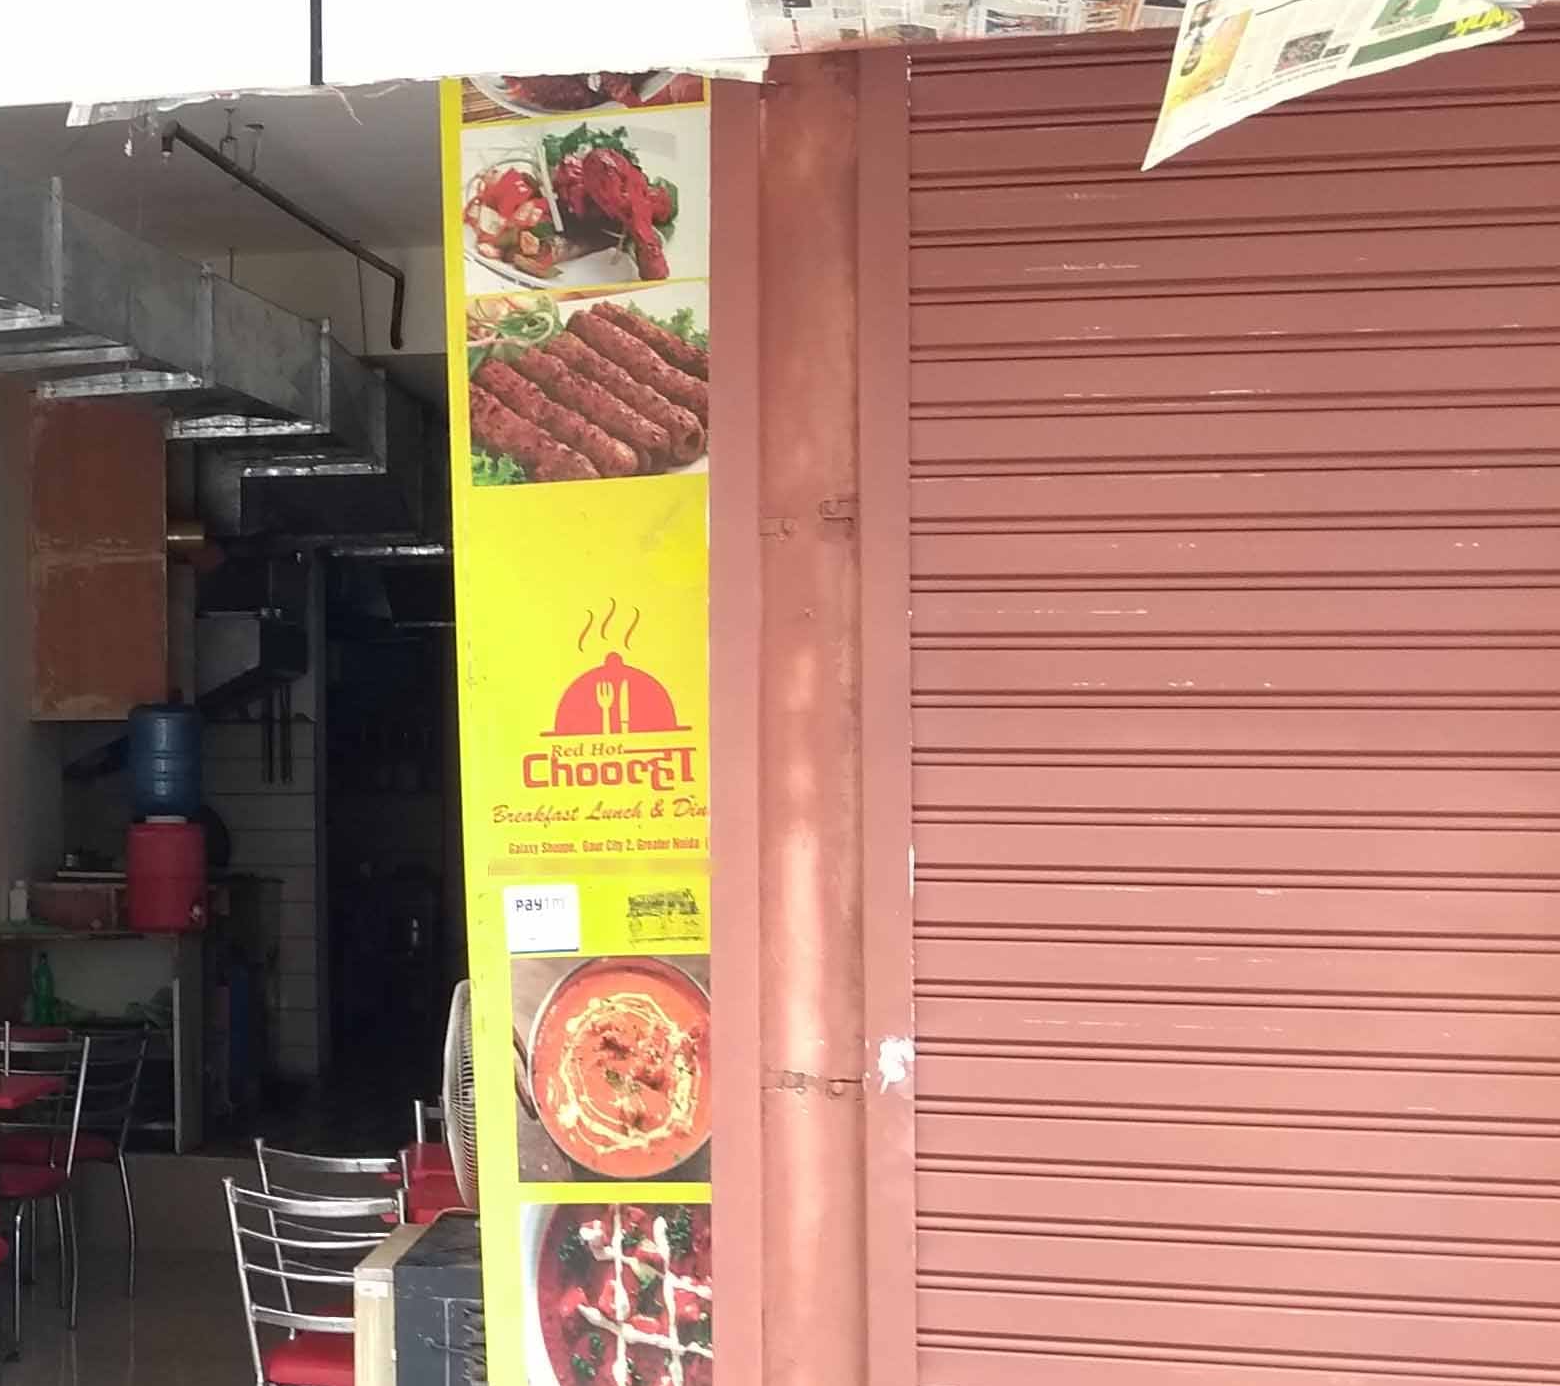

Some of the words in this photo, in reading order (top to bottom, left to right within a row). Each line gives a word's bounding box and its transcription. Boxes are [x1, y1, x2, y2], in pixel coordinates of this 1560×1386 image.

[551, 743, 584, 757] Red
[591, 743, 624, 757] Hot
[492, 804, 580, 829] Breakfast
[584, 800, 644, 821] Lunch
[649, 798, 665, 819] &
